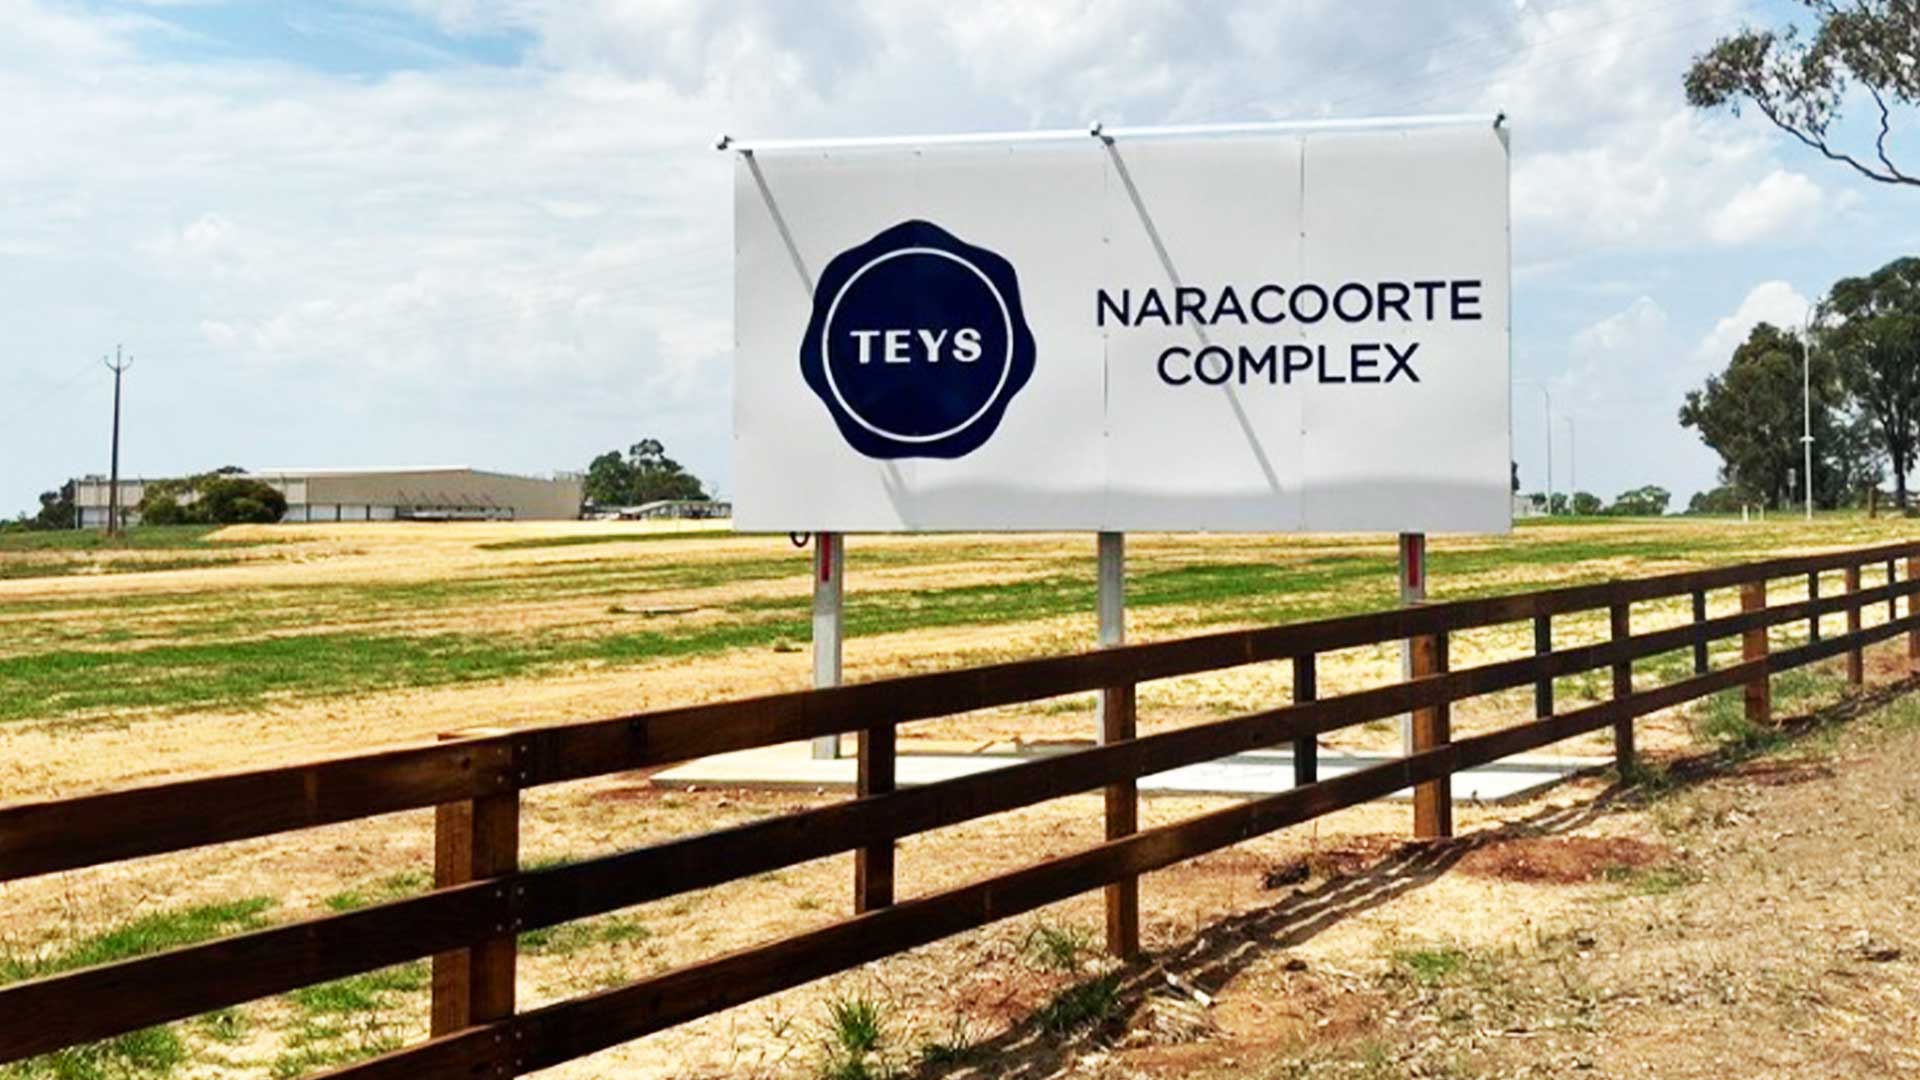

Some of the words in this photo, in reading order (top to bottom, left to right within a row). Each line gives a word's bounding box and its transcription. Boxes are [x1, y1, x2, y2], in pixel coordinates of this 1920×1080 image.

[1097, 280, 1482, 327] NARACOORTE
[850, 327, 983, 365] TEYS
[1157, 342, 1420, 386] COMPLEX
